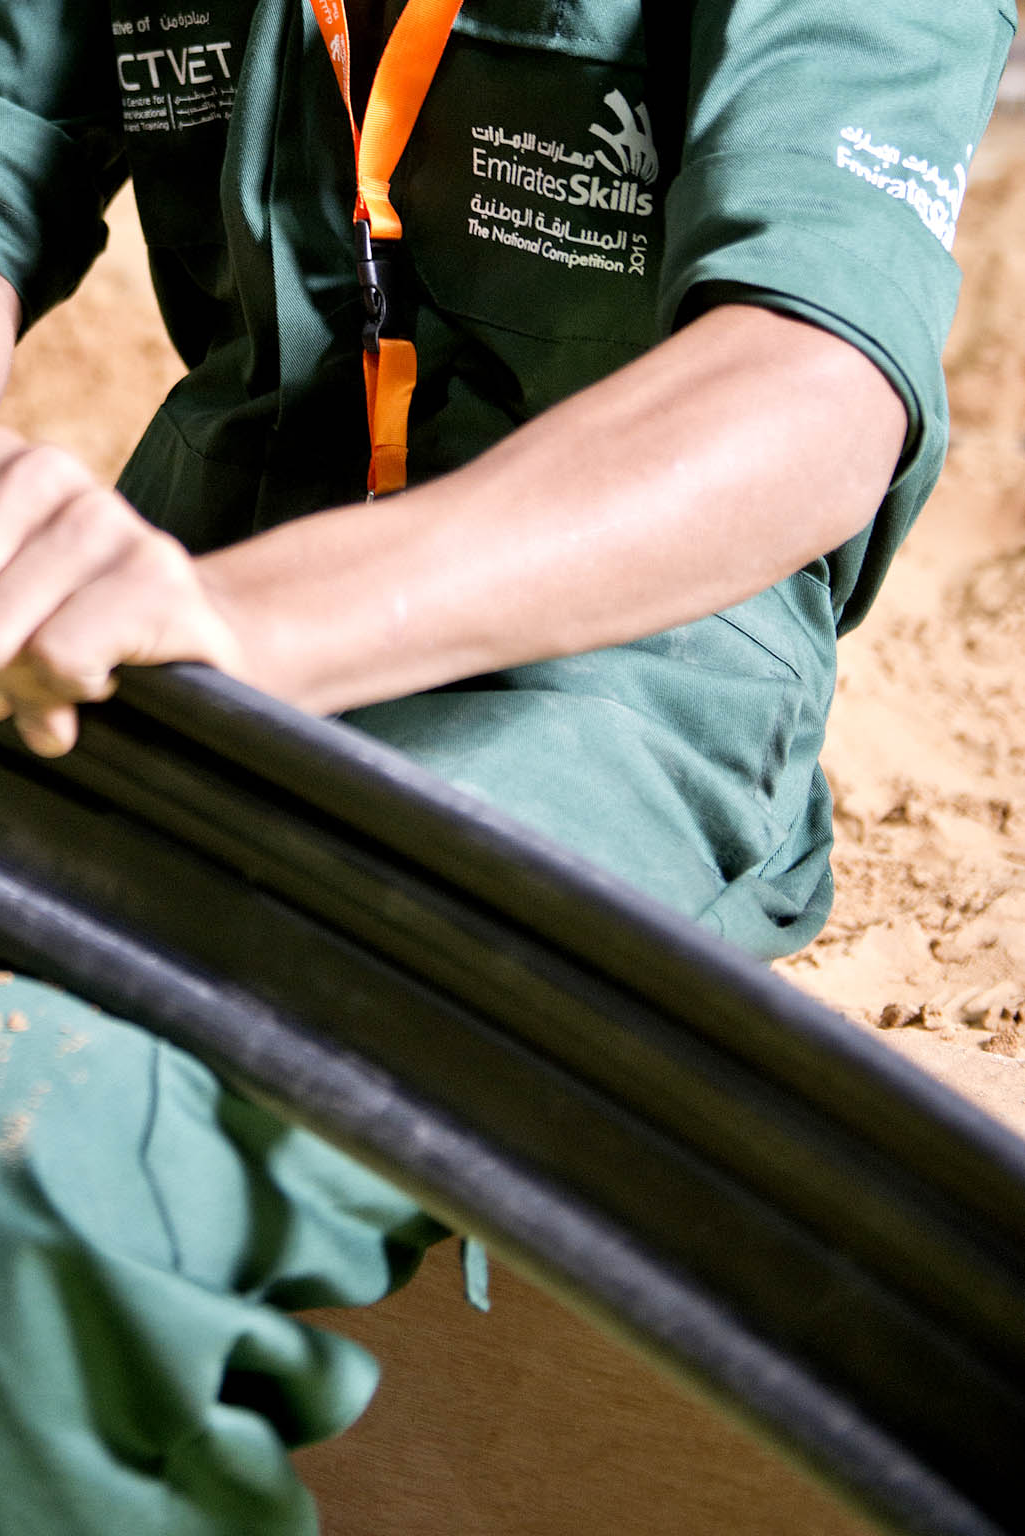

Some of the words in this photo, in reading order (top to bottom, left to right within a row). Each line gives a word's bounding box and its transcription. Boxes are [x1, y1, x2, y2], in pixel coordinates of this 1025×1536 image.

[117, 41, 232, 91] CTVET
[468, 218, 490, 239] The
[492, 225, 542, 254] National
[541, 240, 625, 273] Competition
[628, 233, 648, 276] 2015
